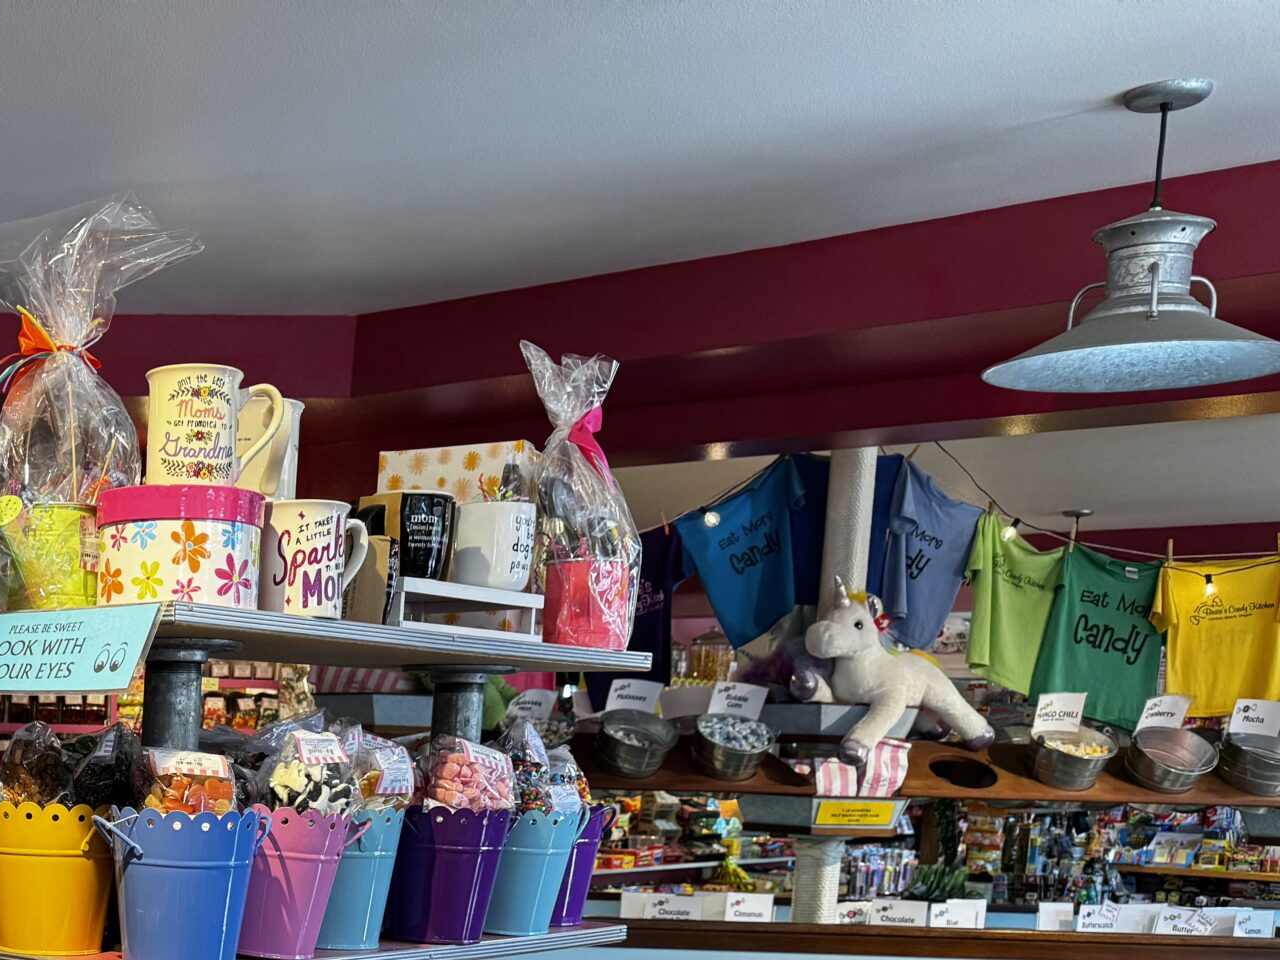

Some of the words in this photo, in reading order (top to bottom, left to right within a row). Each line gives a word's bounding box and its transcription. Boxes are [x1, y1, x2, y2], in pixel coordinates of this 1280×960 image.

[177, 399, 226, 421] Moms
[159, 432, 233, 459] Grandma
[298, 523, 310, 533] IT
[314, 516, 334, 528] TAKES
[411, 515, 437, 523] mom
[296, 537, 302, 545] A
[306, 528, 332, 542] LITTLE
[718, 532, 740, 551] Eat
[741, 511, 774, 535] More
[728, 529, 781, 575] Candy
[1080, 589, 1109, 608] Eat
[9, 624, 40, 635] PLEASE
[42, 623, 53, 633] BE
[53, 621, 85, 633] SWEET
[1074, 614, 1150, 665] Candy
[41, 637, 87, 655] WITH
[35, 662, 75, 680] EYES
[725, 694, 749, 702] Bubble
[726, 701, 742, 709] Gum
[1058, 711, 1079, 719] CHILI
[1242, 715, 1265, 724] Mocha
[658, 908, 691, 917] Chocolate
[733, 909, 763, 918] Cinnamon
[880, 915, 916, 924] Chocolate
[1082, 921, 1114, 929] Butterscotch
[1172, 924, 1194, 934] Butter
[1244, 927, 1262, 935] Lemon
